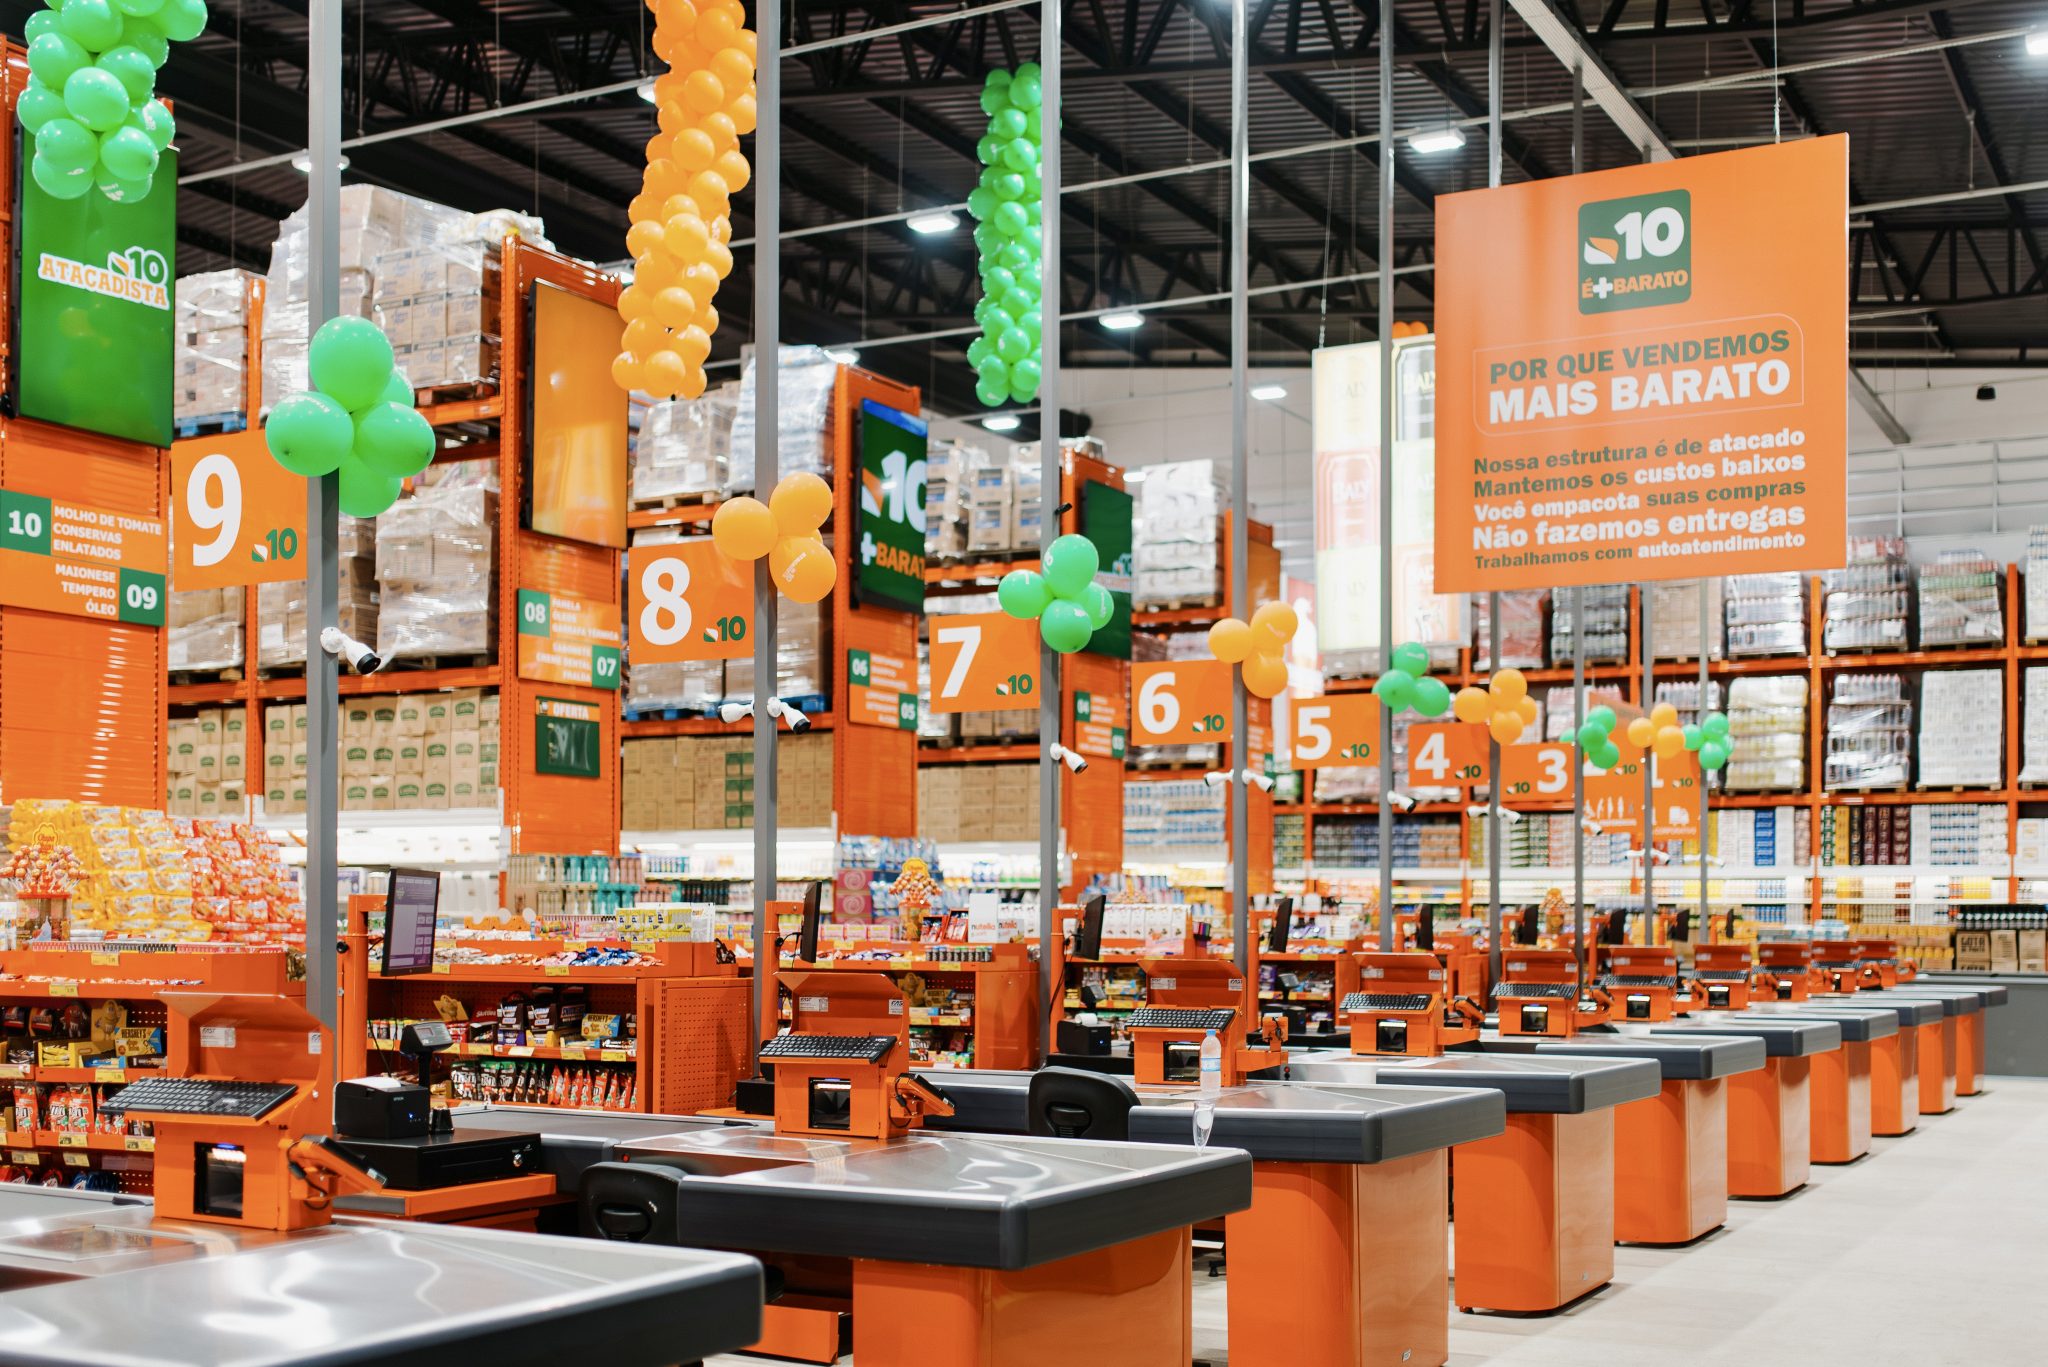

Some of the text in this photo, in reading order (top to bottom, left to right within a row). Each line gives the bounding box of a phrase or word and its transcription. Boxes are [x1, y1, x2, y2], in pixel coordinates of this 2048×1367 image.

[1614, 206, 1685, 260] 10
[40, 256, 168, 307] ATACADISTA
[128, 247, 166, 285] 10
[1490, 329, 1790, 385] POR QUE VENDEMOS
[1489, 358, 1791, 425] MAIS BARATO
[1474, 427, 1806, 475] Nossa estrutura é de atacado
[1474, 453, 1806, 498] Mantemos os custos baixos
[186, 453, 242, 567] 9
[1473, 481, 1807, 522] Você empacota suas compras
[8, 510, 42, 538] 10
[53, 522, 122, 545] CONSERVAS
[54, 505, 162, 535] MOLHO DE TOMATE
[1472, 504, 1807, 550] Não fazemos entregas
[53, 539, 121, 561] ENLATADOS
[265, 527, 298, 561] 10
[1475, 531, 1806, 569] Trabalhamos com autoatendimento
[55, 563, 116, 583] MAIONESE
[61, 581, 116, 600] TEMPERO
[126, 584, 158, 610] 09
[640, 557, 692, 646] 8
[85, 598, 116, 616] ÓLEO
[524, 601, 547, 624] 08
[716, 615, 746, 641] 10
[596, 655, 617, 678] 07
[852, 658, 869, 677] 06
[937, 625, 981, 698] 7
[1008, 674, 1033, 694] 10
[553, 700, 590, 720] OFERTA
[1138, 671, 1180, 735] 6
[1203, 714, 1225, 732] 10
[1295, 705, 1332, 760] 5
[1350, 743, 1370, 758] 10
[1414, 732, 1450, 780] 4
[1463, 765, 1481, 779] 10
[1514, 782, 1531, 794] 10
[1537, 749, 1568, 793] 3
[1623, 764, 1637, 775] 10
